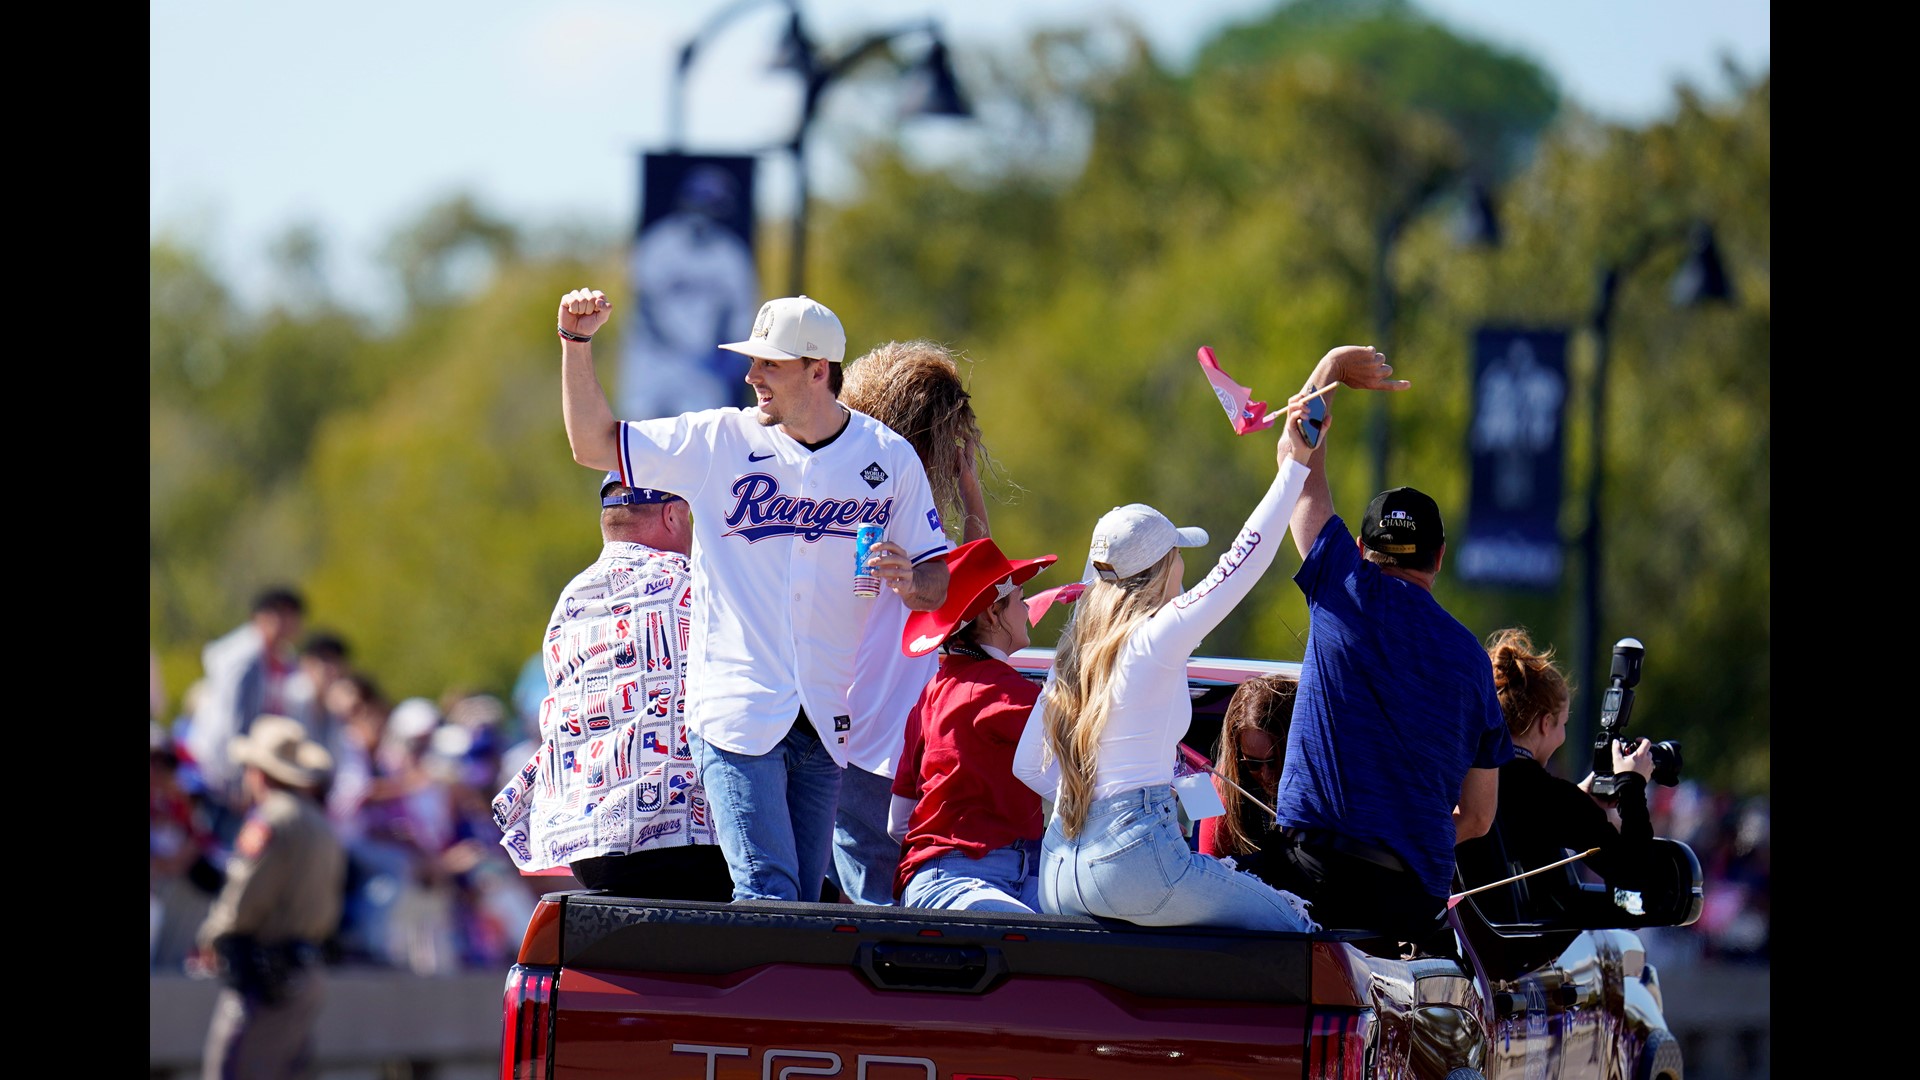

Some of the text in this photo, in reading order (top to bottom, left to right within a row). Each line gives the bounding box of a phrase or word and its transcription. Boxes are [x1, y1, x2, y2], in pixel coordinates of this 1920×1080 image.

[643, 489, 653, 499] T
[722, 472, 894, 542] Rangers
[1379, 518, 1416, 531] CHAMPS
